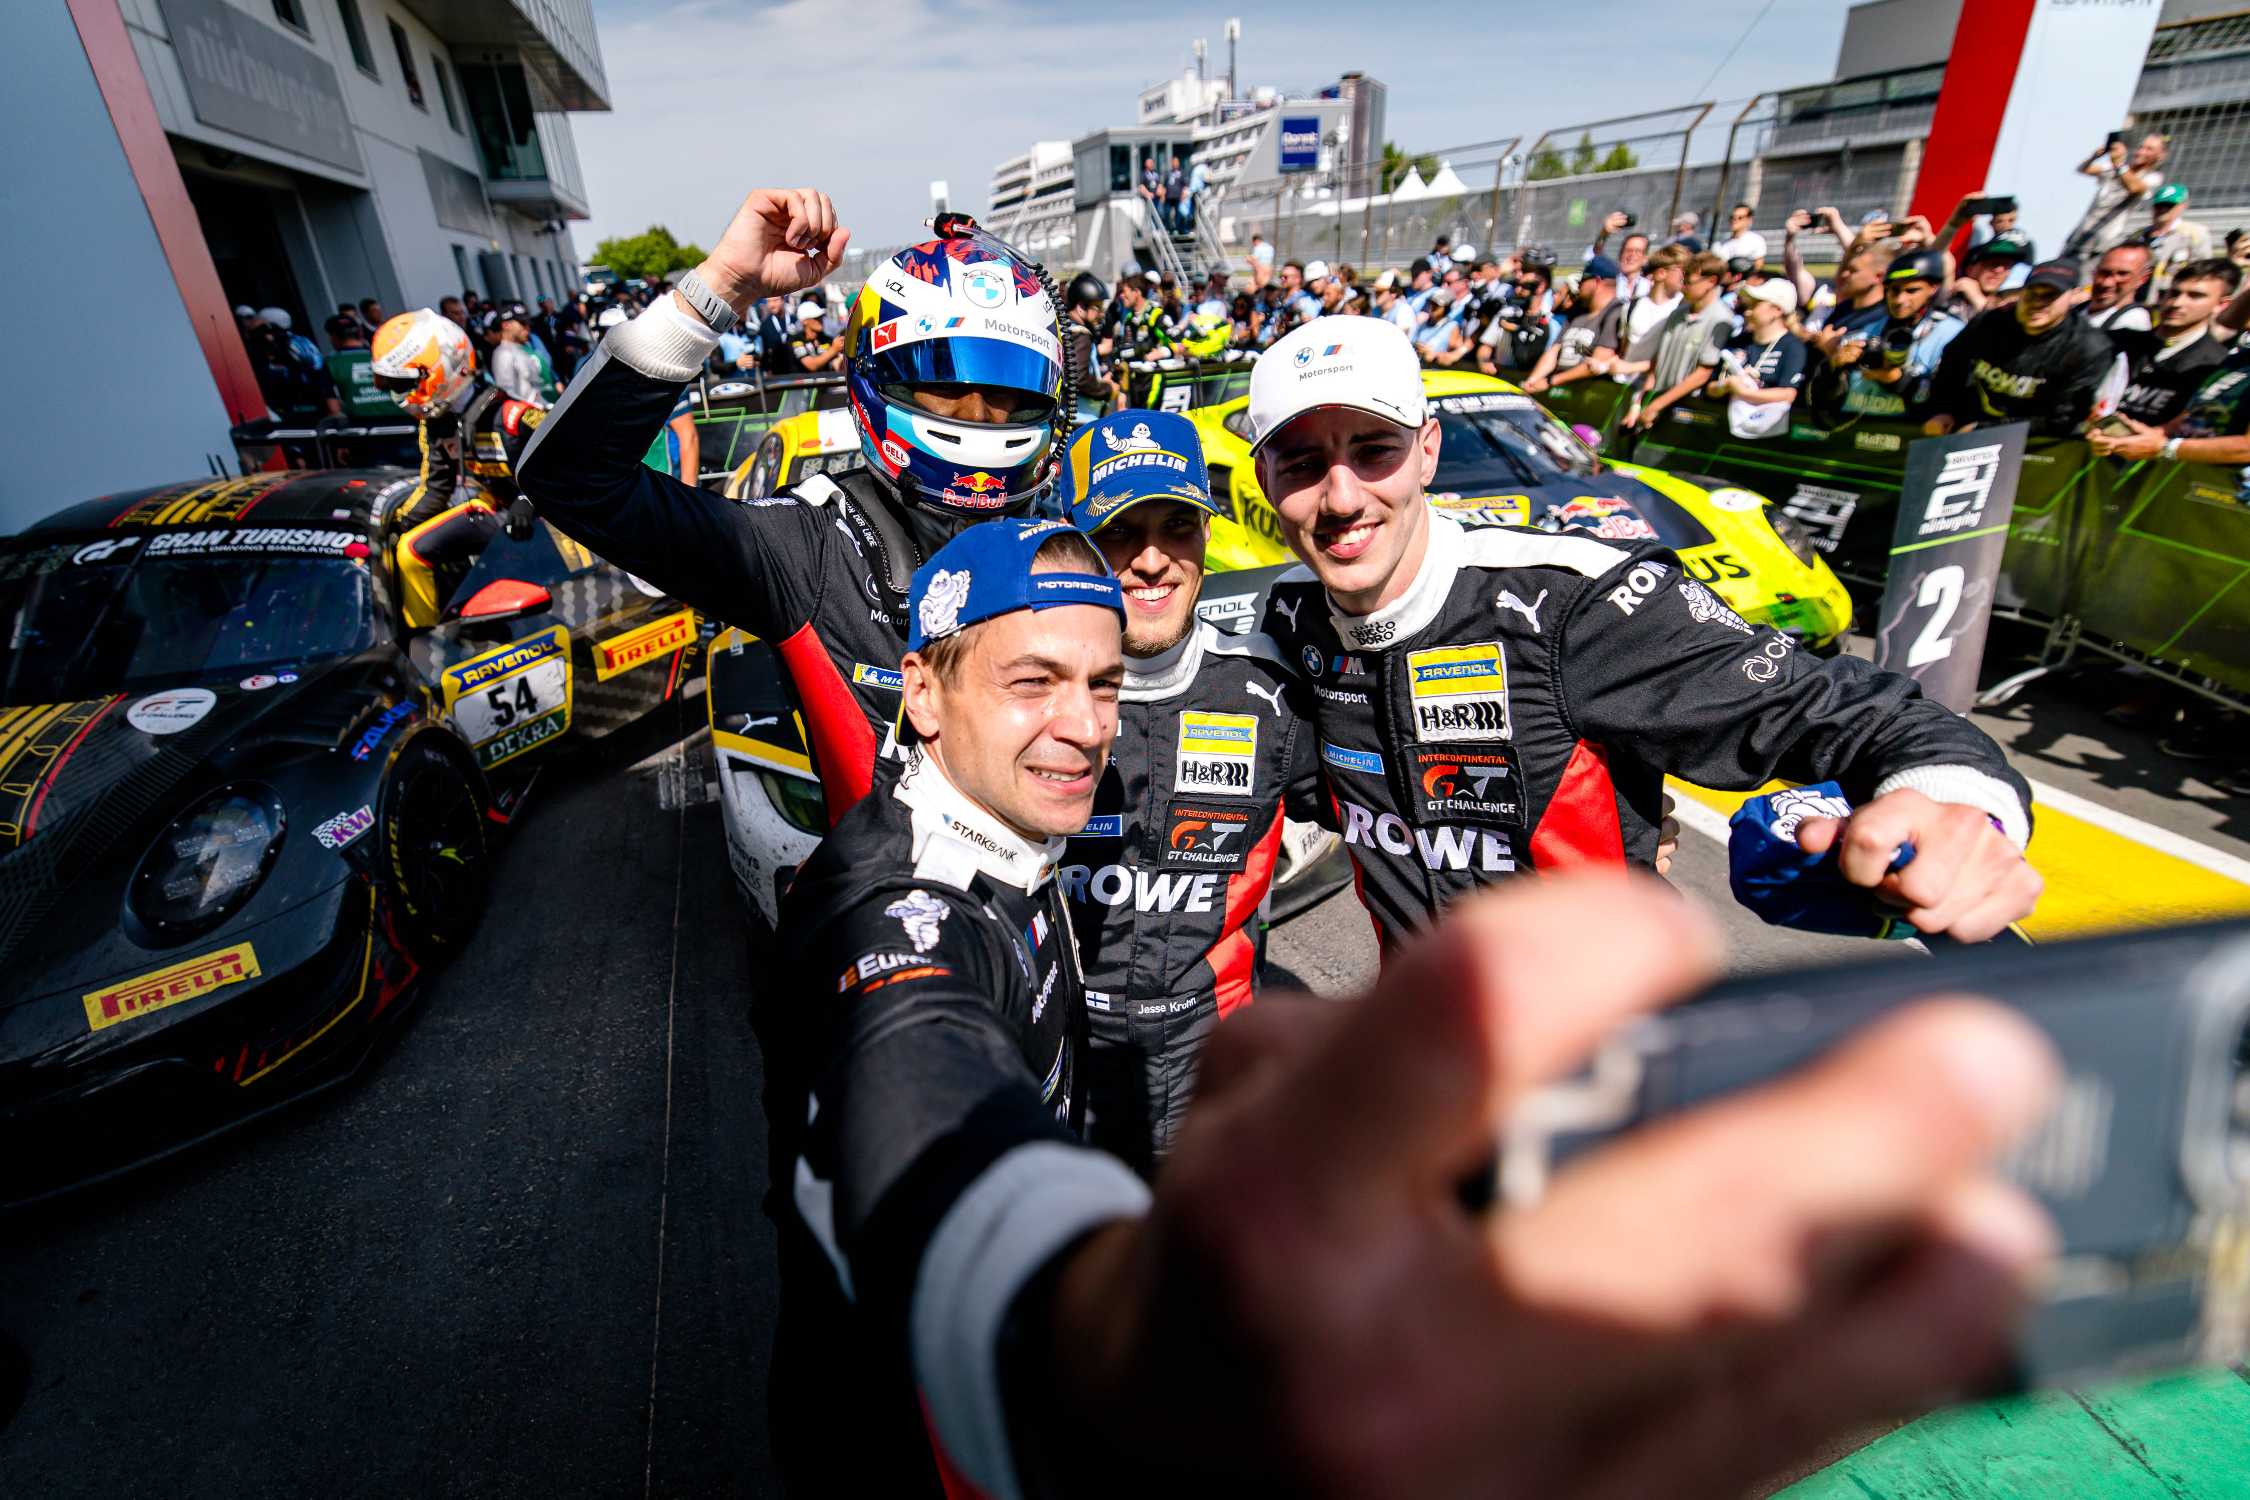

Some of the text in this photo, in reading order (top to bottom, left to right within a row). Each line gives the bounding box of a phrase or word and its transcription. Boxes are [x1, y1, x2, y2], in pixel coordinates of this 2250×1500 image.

[984, 316, 1051, 350] Motorsport
[1299, 365, 1353, 382] Motorsport
[885, 443, 906, 463] BELL
[1092, 453, 1187, 485] MICHELIN
[942, 488, 1007, 509] Red Bull
[149, 529, 355, 550] GRAN TURISMO
[1037, 582, 1114, 593] MOTORSPORT
[1197, 602, 1247, 617] ENOL
[1907, 564, 1965, 667] 2
[604, 618, 688, 670] PIRELLI
[462, 641, 554, 687] RAVENOL
[1423, 663, 1491, 679] RAVENOL
[486, 675, 538, 728] 54
[1313, 683, 1369, 705] Motorsport
[1419, 701, 1480, 732] H&R
[489, 714, 561, 761] DEKRA
[1190, 727, 1247, 739] RAVENOL
[1328, 751, 1375, 768] MICHELIN
[1417, 754, 1507, 764] INTERCONTINENTAL
[1181, 760, 1230, 787] H&R
[1174, 808, 1249, 822] INTERCONTINENTAL
[1427, 799, 1516, 814] GT CHALLENGE
[329, 805, 373, 845] KW
[1085, 822, 1113, 831] ELIN
[952, 820, 1018, 862] STARKBANK
[1344, 800, 1516, 872] ROWE
[1167, 850, 1240, 863] GT CHALLENGE
[1060, 864, 1218, 913] ROWE
[99, 951, 245, 1019] PIRELLI
[1138, 996, 1197, 1016] Jesse Krohn
